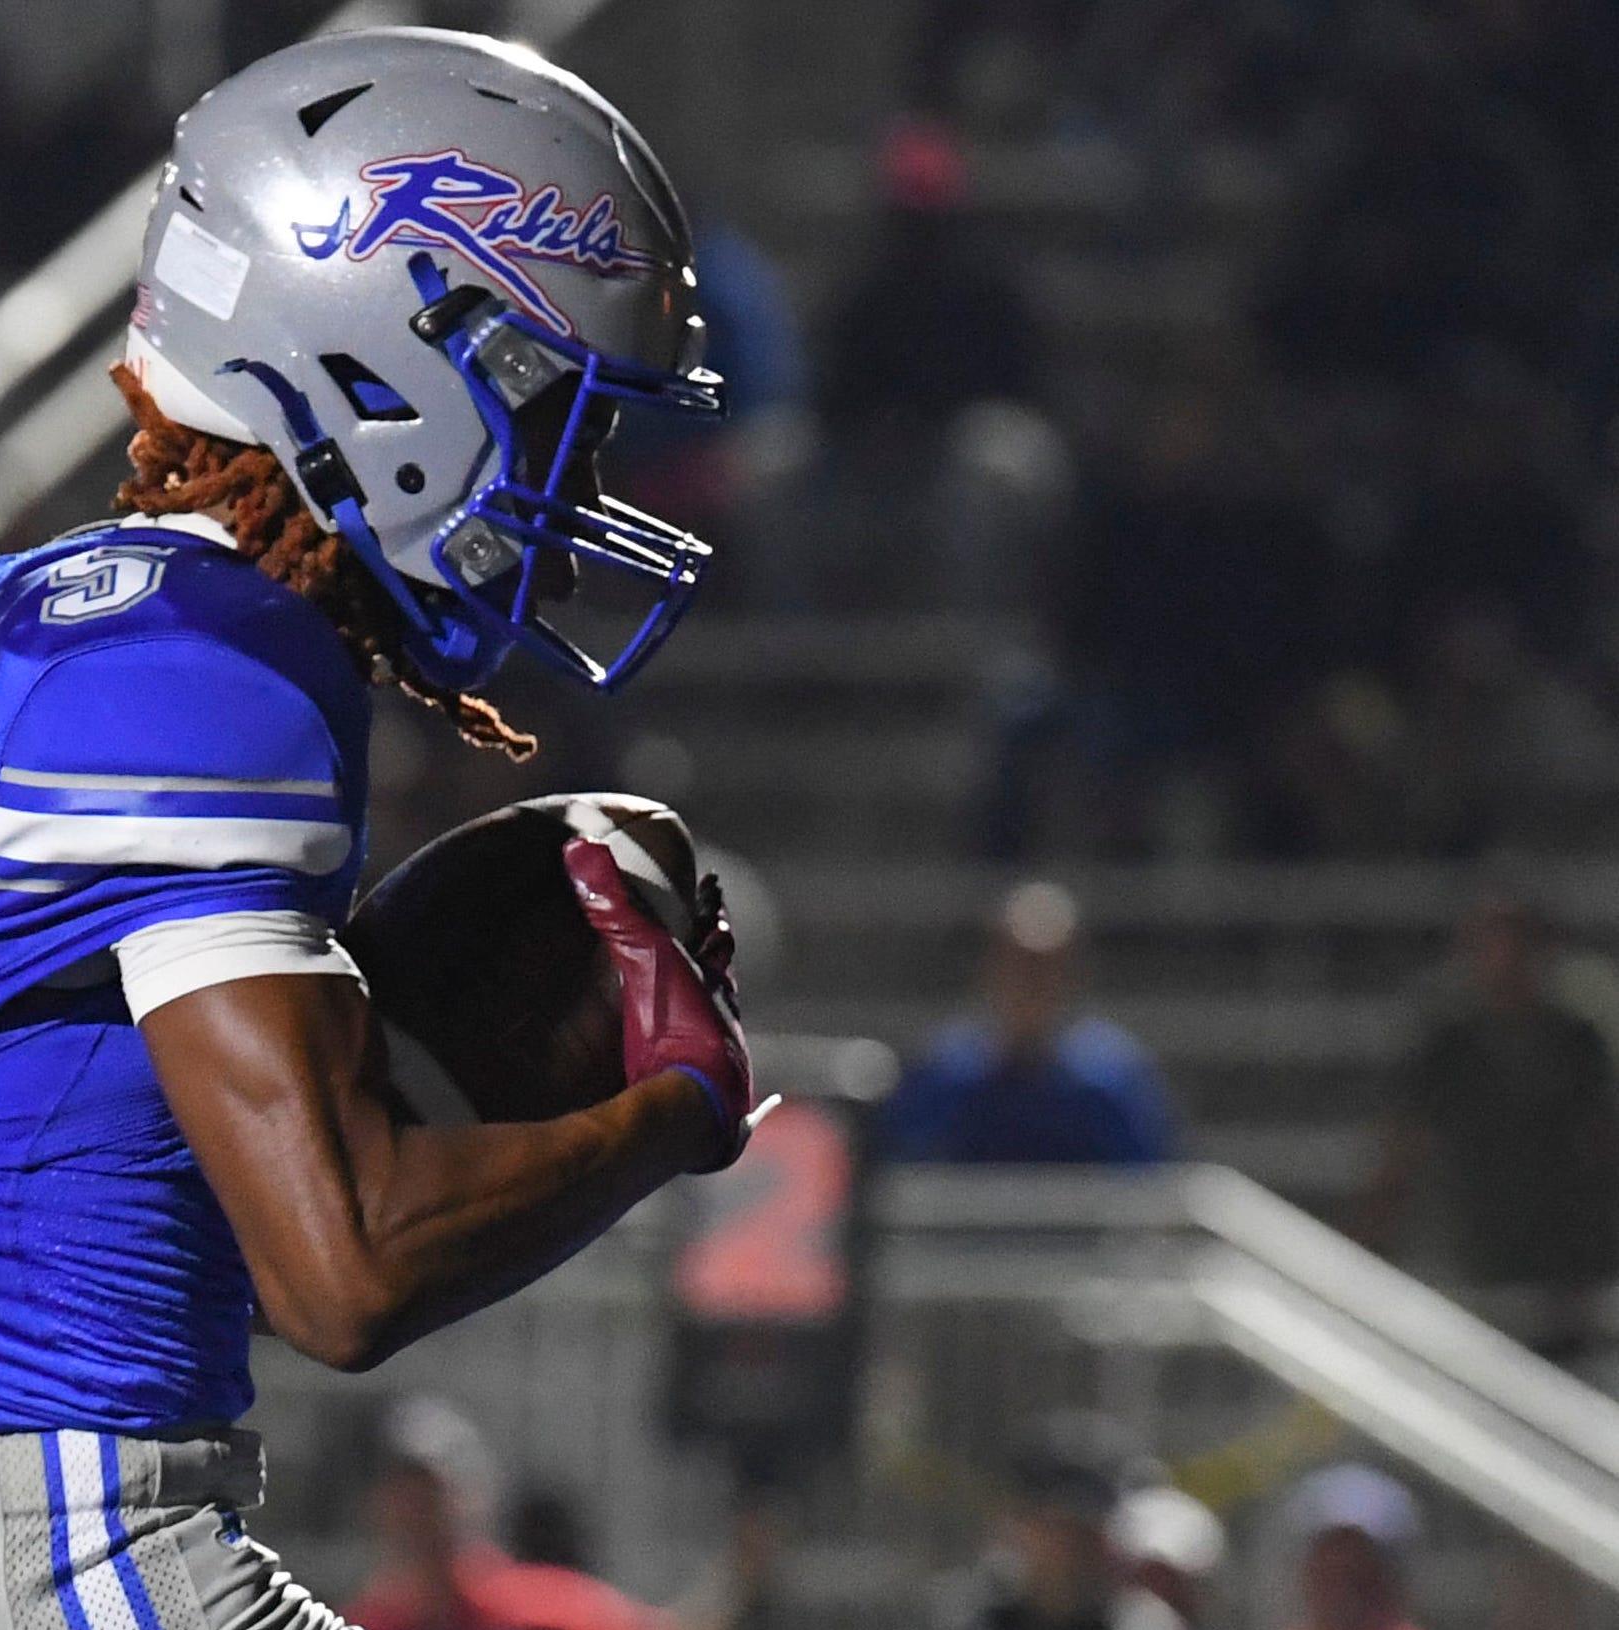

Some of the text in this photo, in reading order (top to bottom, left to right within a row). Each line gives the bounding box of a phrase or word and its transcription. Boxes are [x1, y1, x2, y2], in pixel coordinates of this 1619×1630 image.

[347, 149, 649, 338] Rebels
[39, 545, 177, 626] 5
[673, 1098, 851, 1322] 2
